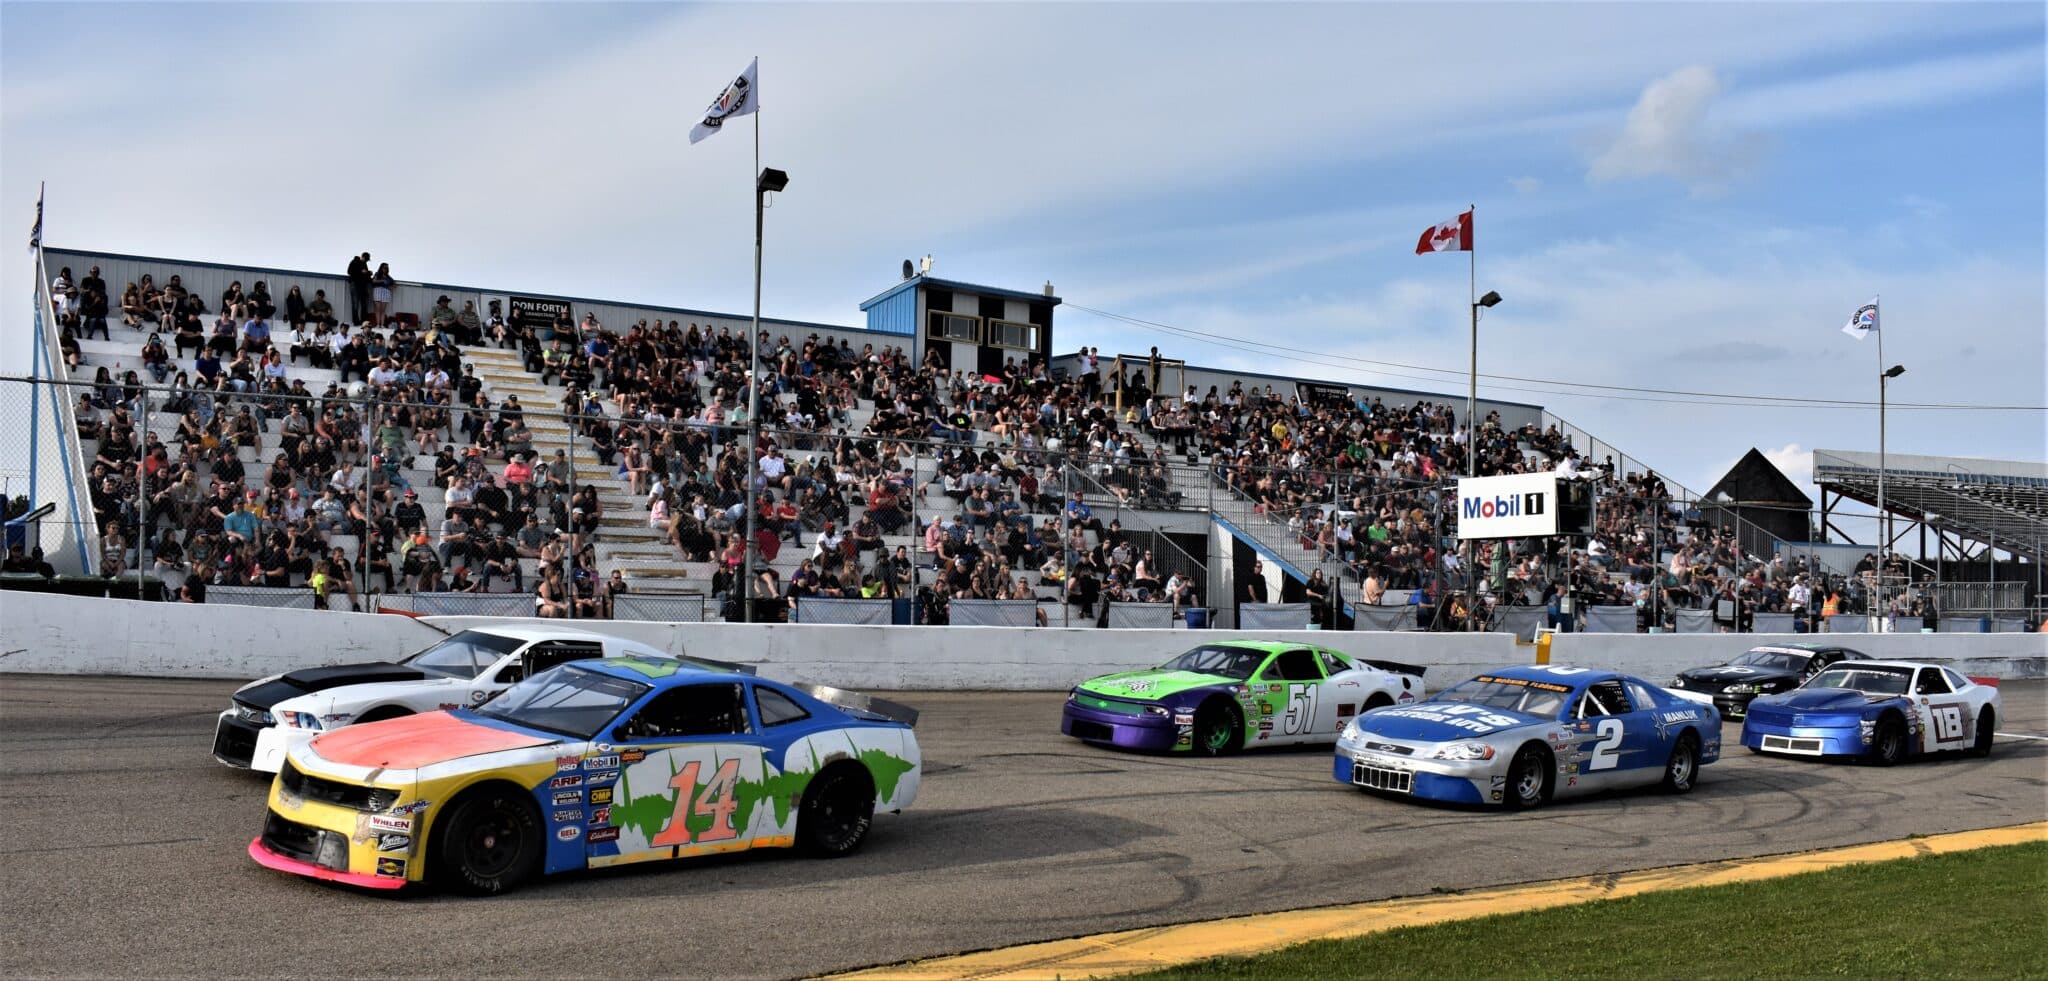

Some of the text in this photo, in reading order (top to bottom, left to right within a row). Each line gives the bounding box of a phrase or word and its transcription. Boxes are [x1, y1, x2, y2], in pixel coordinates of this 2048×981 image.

[513, 301, 534, 310] DON
[1464, 494, 1520, 519] Mobil
[1284, 683, 1319, 735] 51
[1931, 706, 1964, 740] 18
[1589, 718, 1625, 771] 2
[557, 763, 578, 772] MSD
[586, 757, 609, 769] Mobil
[591, 791, 612, 801] OMP
[650, 758, 741, 848] 14
[373, 816, 410, 829] WHELEN
[561, 828, 577, 837] BELL
